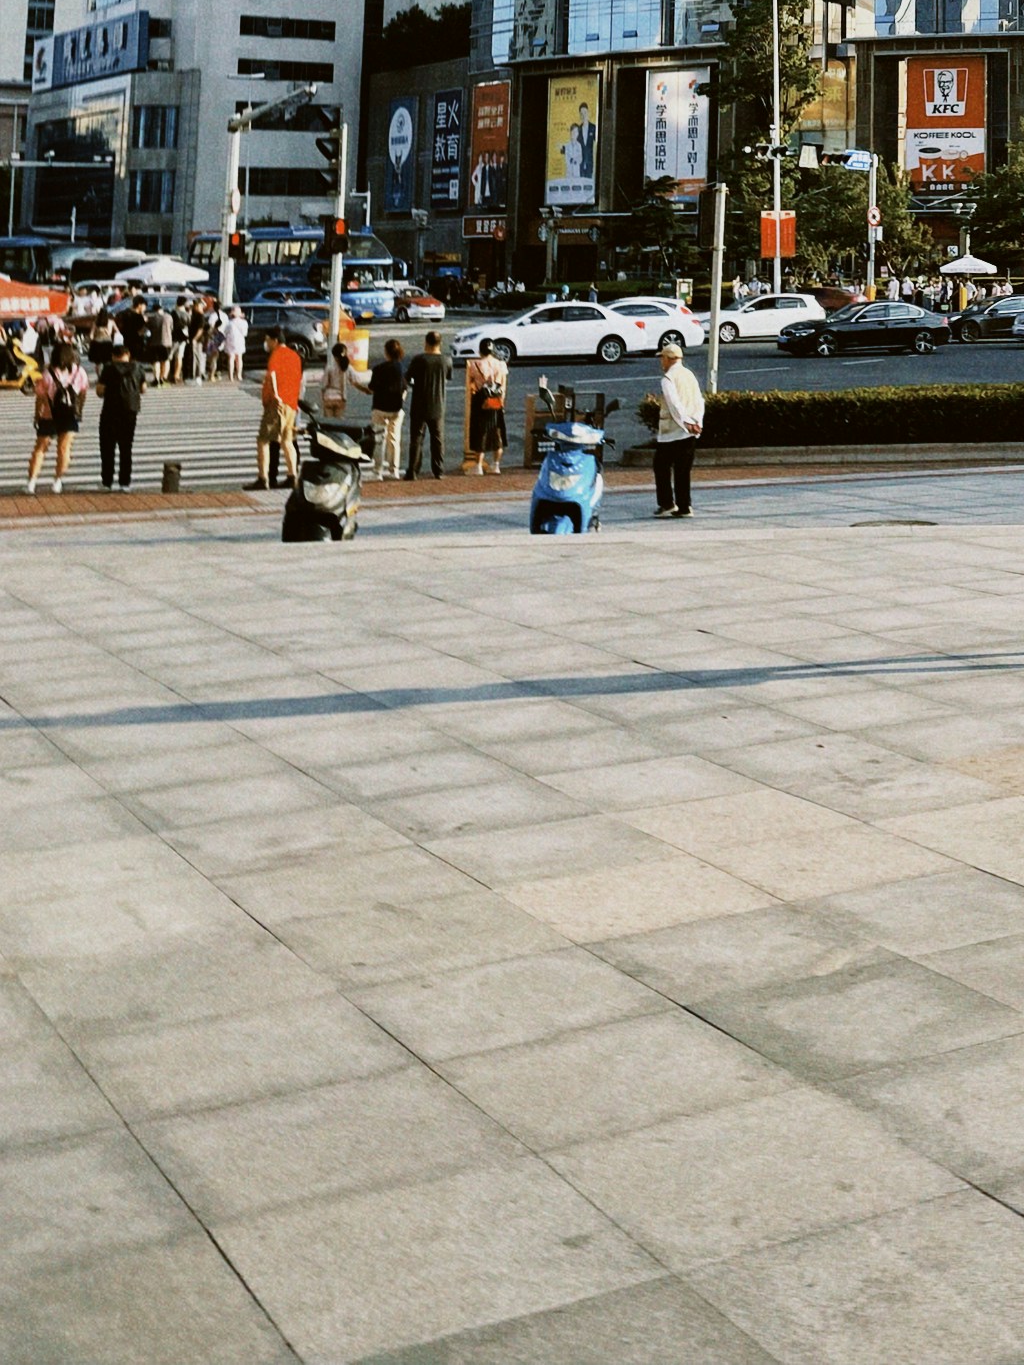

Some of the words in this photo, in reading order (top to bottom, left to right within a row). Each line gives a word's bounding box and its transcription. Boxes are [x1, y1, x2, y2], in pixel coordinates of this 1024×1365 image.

[436, 99, 460, 129] 星火
[932, 104, 959, 114] KFC
[434, 134, 460, 162] 教育
[655, 104, 667, 171] 学而思培优
[951, 131, 976, 139] KOOL
